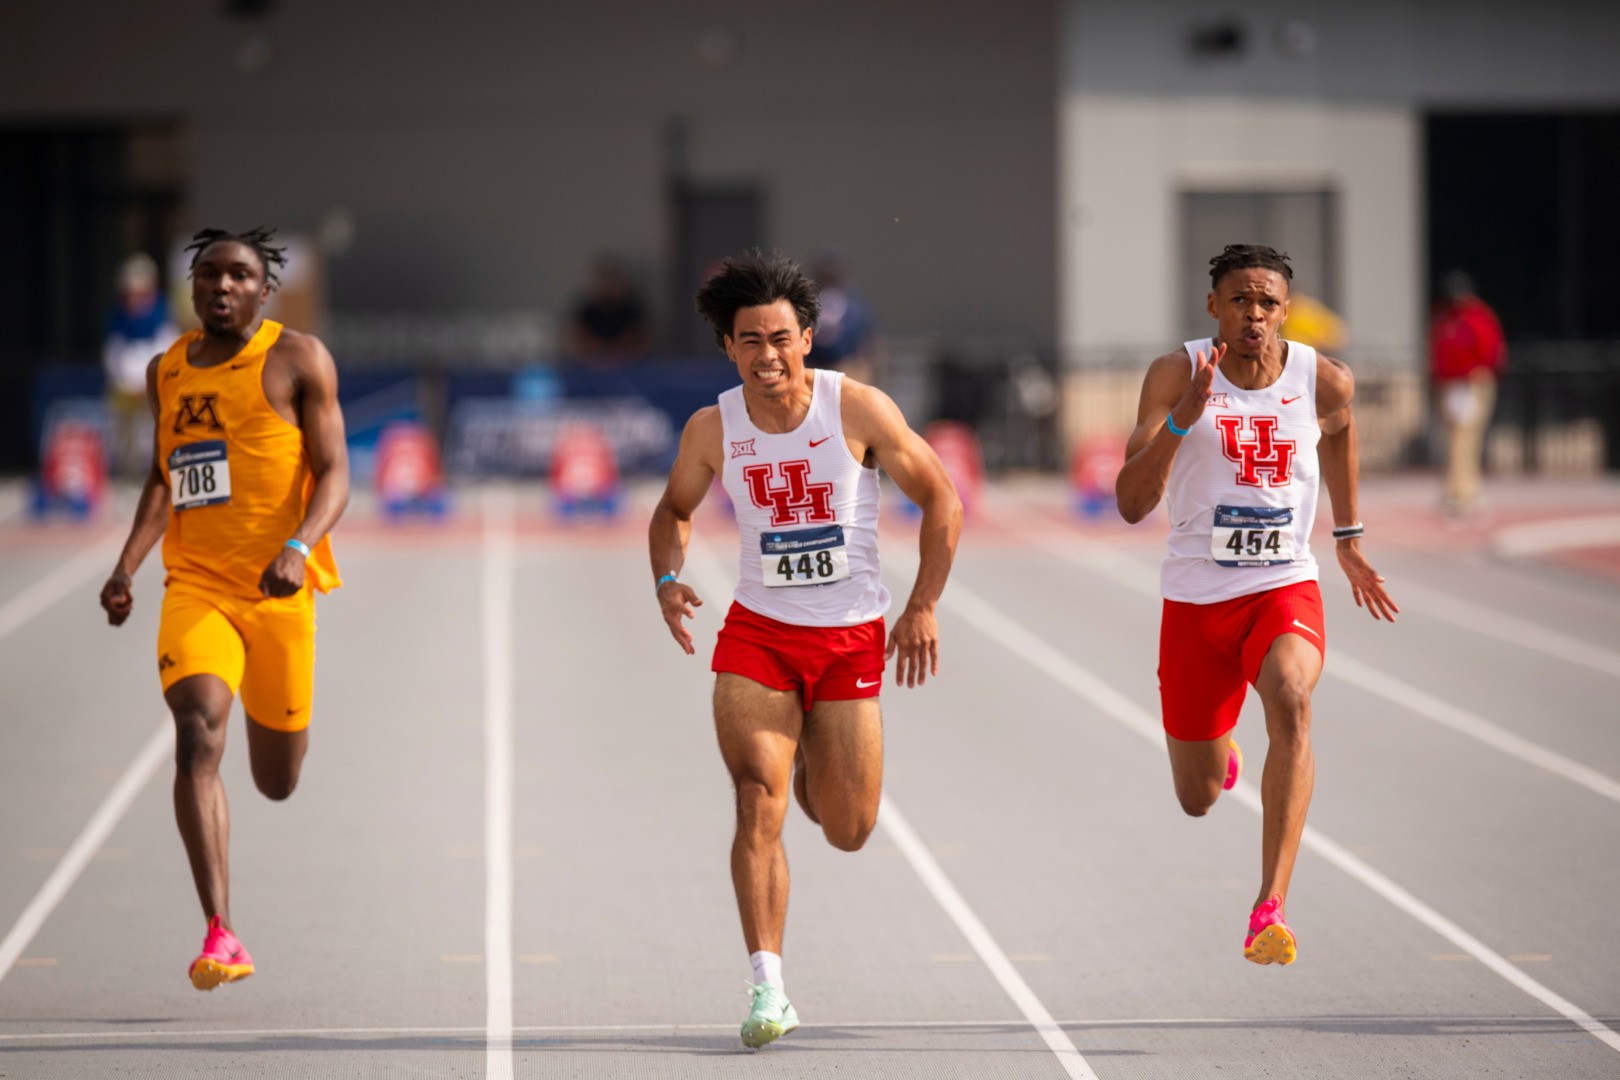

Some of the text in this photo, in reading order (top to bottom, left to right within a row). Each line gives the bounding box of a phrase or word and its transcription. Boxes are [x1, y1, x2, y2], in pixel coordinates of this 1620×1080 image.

[1216, 415, 1297, 488] UH
[178, 462, 216, 498] 708
[743, 459, 836, 527] UH
[1226, 530, 1280, 555] 454
[777, 550, 834, 581] 448
